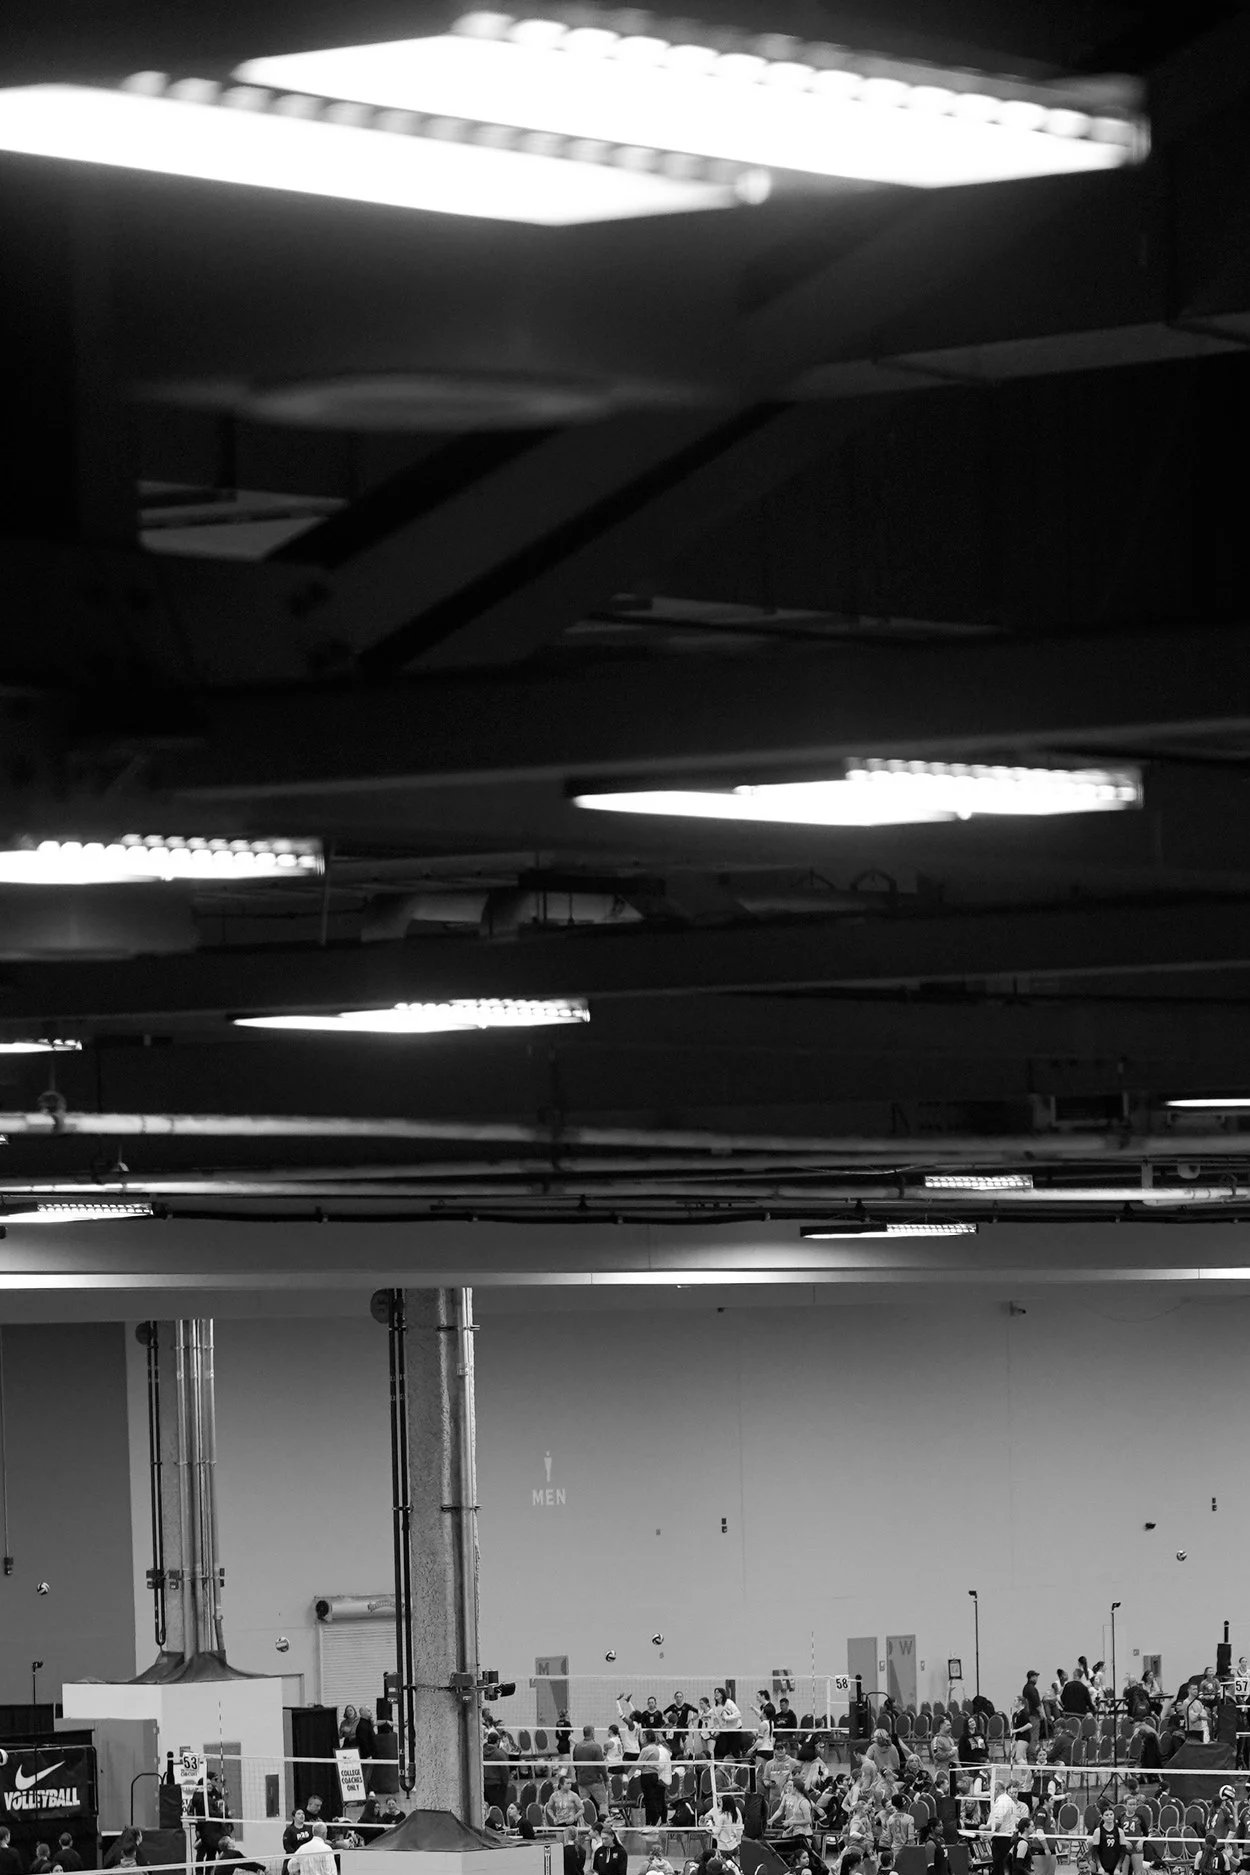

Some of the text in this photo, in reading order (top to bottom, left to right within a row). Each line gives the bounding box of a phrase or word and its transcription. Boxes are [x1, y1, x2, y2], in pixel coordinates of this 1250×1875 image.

[532, 1488, 566, 1506] MEN
[836, 1678, 848, 1689] 58
[1236, 1680, 1248, 1692] 57
[184, 1756, 198, 1769] 53
[341, 1769, 361, 1777] COLLEGE
[342, 1776, 363, 1784] COACHES
[346, 1784, 360, 1792] ONLY
[3, 1787, 81, 1811] VOLLEYBALL
[1123, 1821, 1136, 1832] 24
[1106, 1838, 1116, 1848] 99
